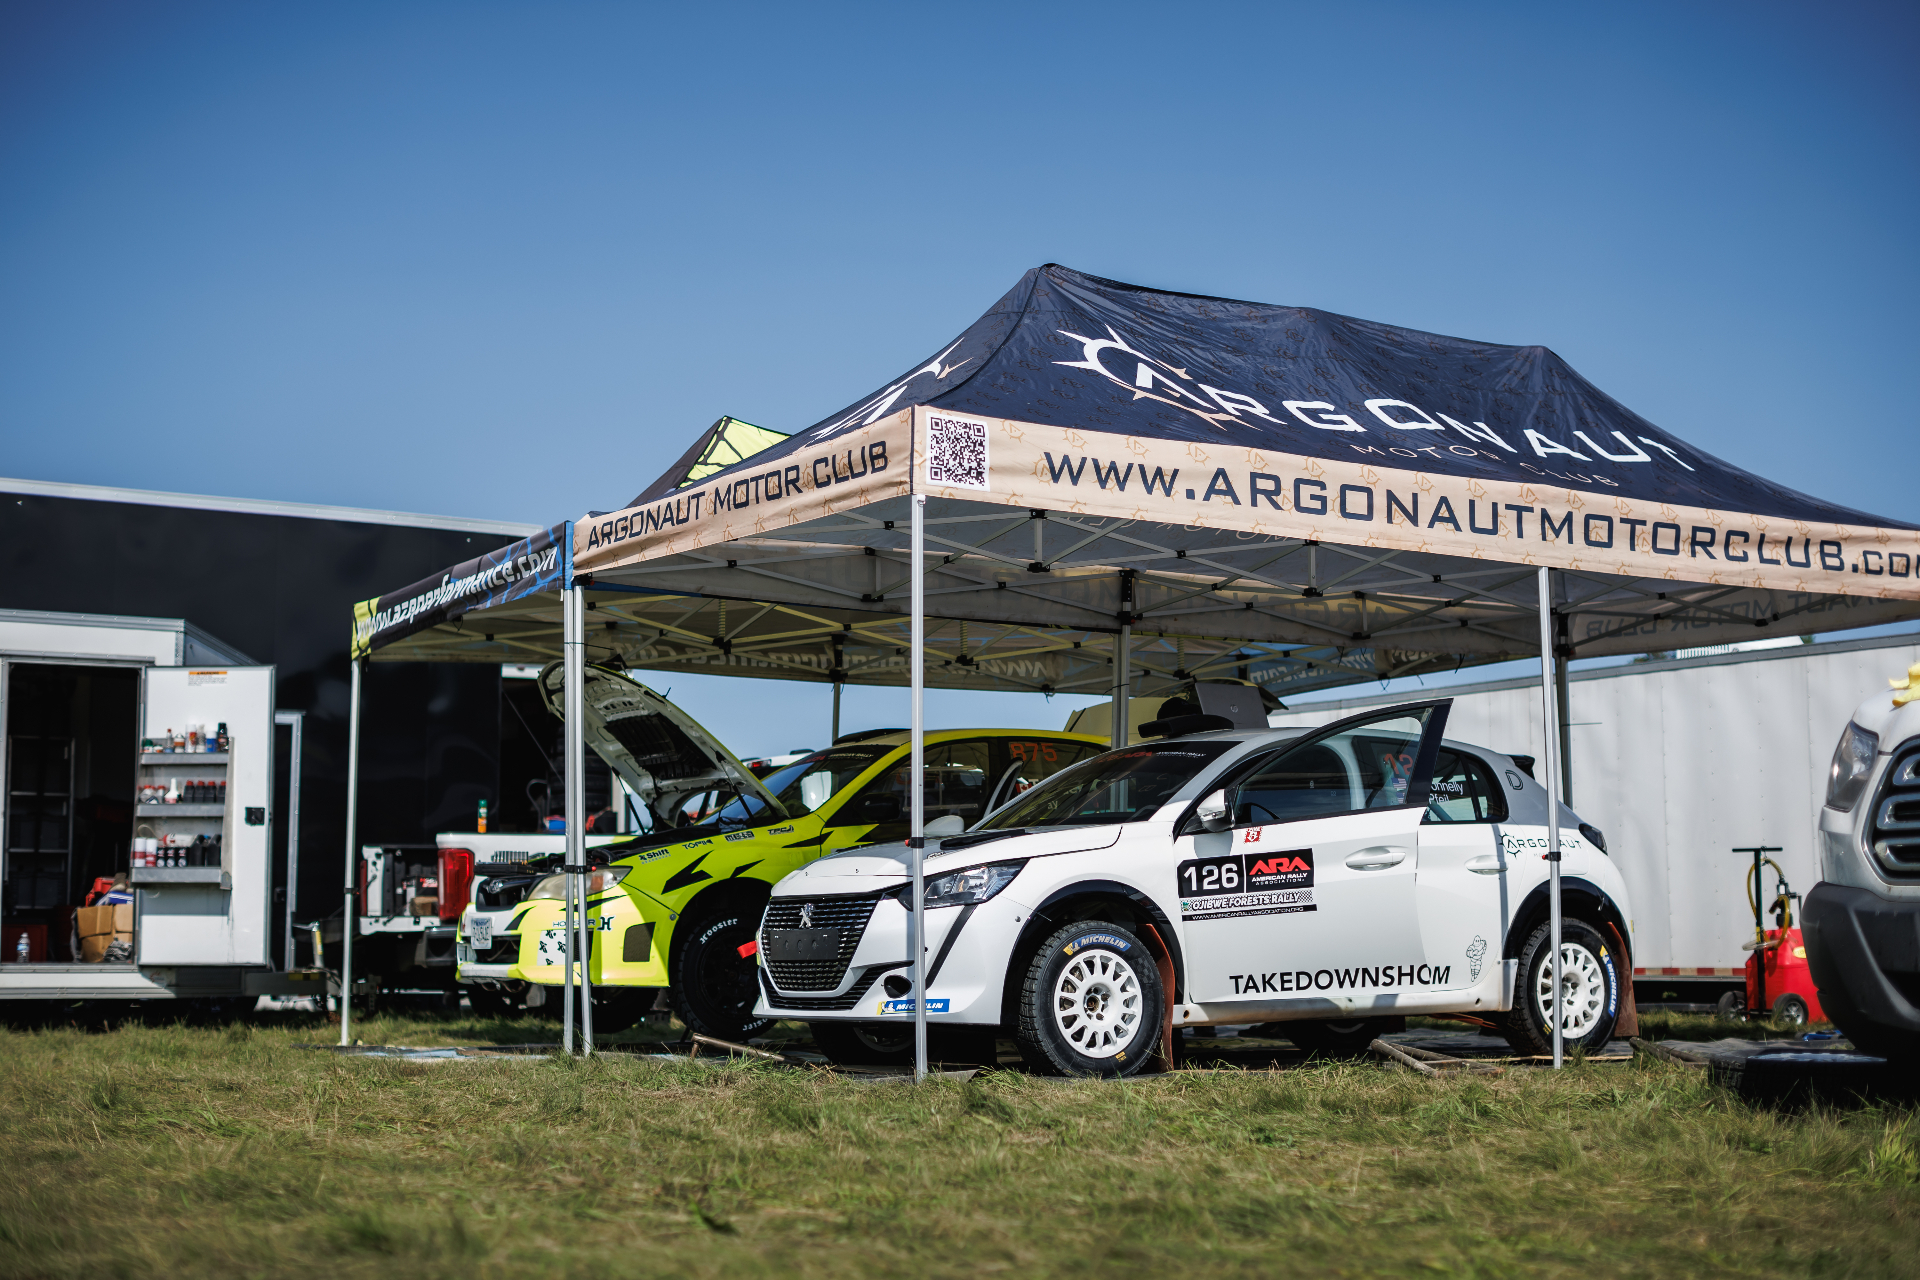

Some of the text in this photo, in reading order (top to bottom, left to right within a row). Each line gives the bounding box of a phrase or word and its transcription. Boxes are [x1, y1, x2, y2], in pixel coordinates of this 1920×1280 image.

[1136, 362, 1695, 471] ARGONAUT
[587, 440, 889, 551] ARGONAUT MOTOR CLUB
[1010, 743, 1058, 762] 875
[1431, 781, 1463, 795] onnelly
[1507, 838, 1581, 849] ARGOAUT
[1249, 857, 1311, 875] ARA
[1183, 863, 1239, 891] 126
[1251, 874, 1286, 882] AMERICAN
[1192, 893, 1301, 910] OJIBWE FORESTS RALLY
[1081, 934, 1126, 949] MICHELIN
[1607, 963, 1617, 1013] MICHELIN
[895, 1002, 944, 1010] MICLIN
